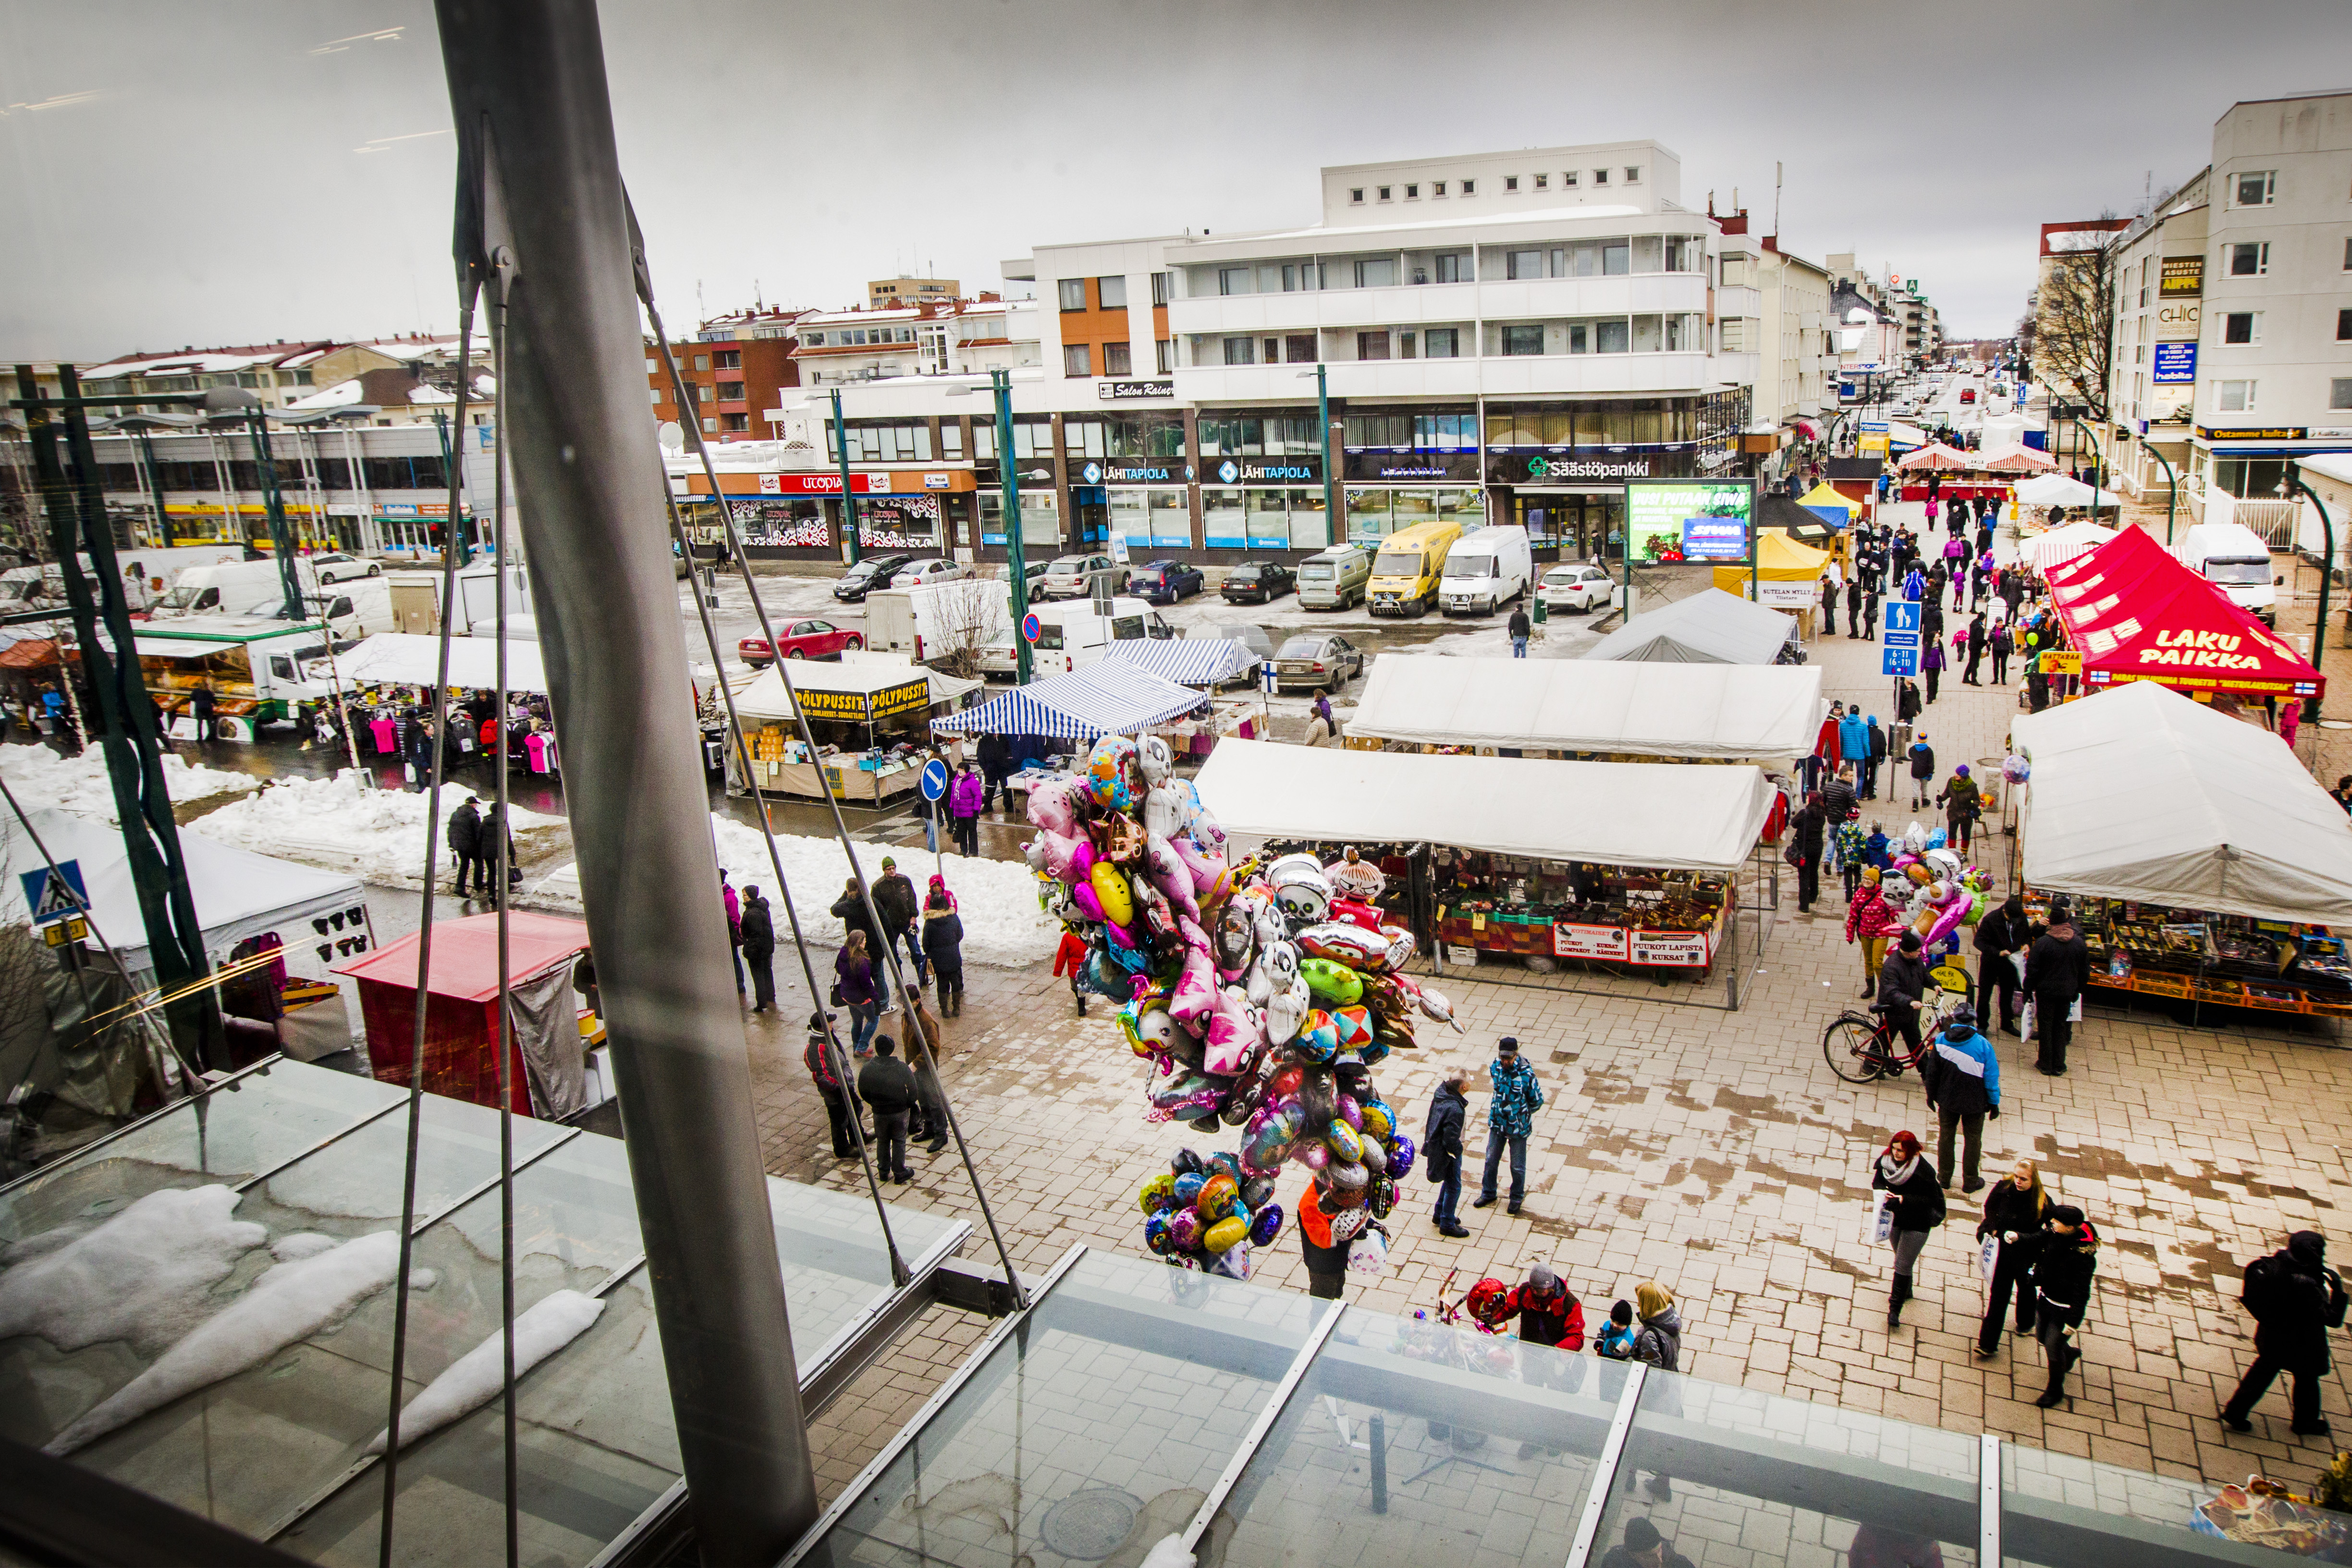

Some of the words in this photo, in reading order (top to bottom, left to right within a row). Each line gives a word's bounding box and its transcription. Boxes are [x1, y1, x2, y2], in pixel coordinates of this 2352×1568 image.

[2159, 305, 2198, 322] CHIC
[2156, 372, 2193, 380] habita
[1115, 384, 1143, 396] Salon
[2214, 430, 2260, 438] Ostamme
[1102, 466, 1169, 479] LÄHITAPIOLA
[1239, 465, 1311, 479] LÄHITAPIOLA
[1380, 466, 1447, 477] ALEXANDRIA
[1550, 461, 1649, 479] Säästöpankki
[1633, 491, 1661, 505] UUSI
[1662, 491, 1711, 505] PUTAAN
[1713, 492, 1746, 506] SIWA
[1690, 526, 1741, 536] SIWA
[2155, 629, 2242, 651] LAKU
[2139, 649, 2262, 670] PAIKKA
[871, 682, 928, 710] PÖLYPUSSIT
[828, 781, 842, 790] USSIT
